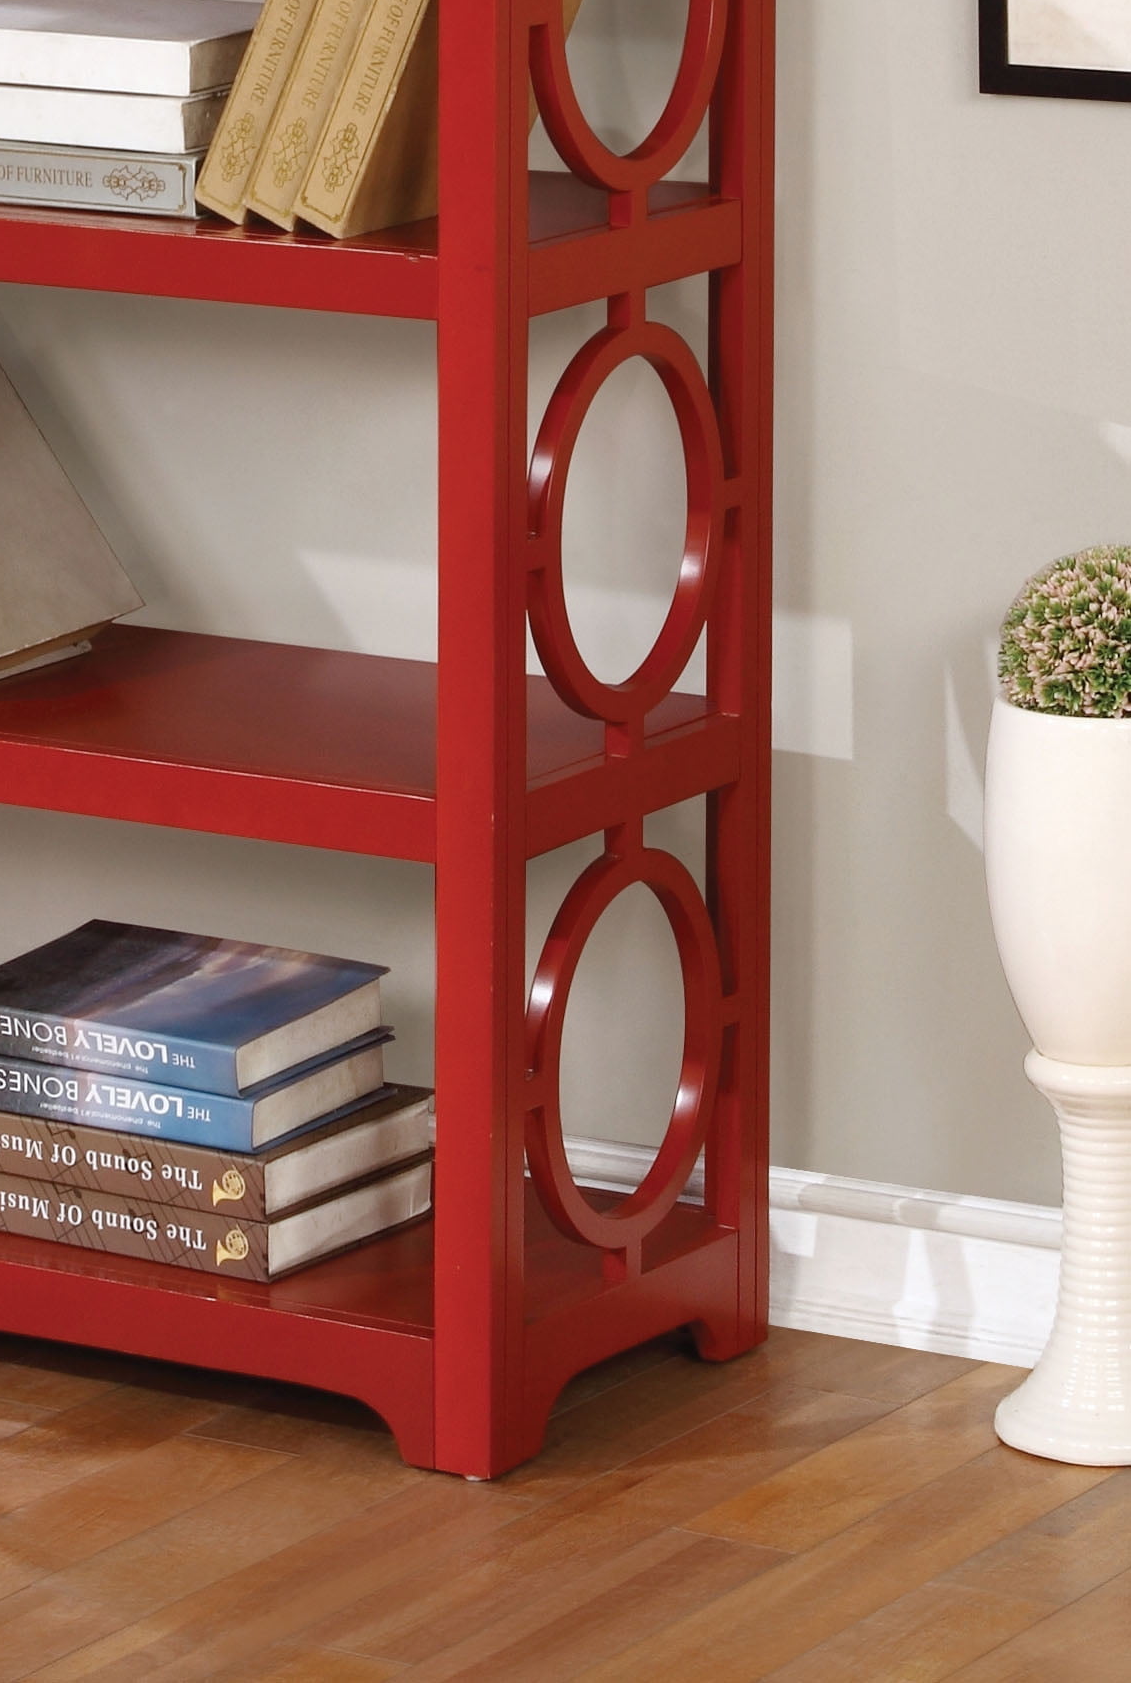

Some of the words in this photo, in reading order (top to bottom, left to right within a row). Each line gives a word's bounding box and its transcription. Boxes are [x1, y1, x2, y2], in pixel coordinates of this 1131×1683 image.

[335, 1, 352, 25] OF
[386, 5, 404, 29] OF
[251, 19, 294, 106] FURNITURE
[301, 21, 346, 110] FURNITURE
[353, 26, 396, 116] FURNITURE
[16, 166, 93, 188] FURNITURE
[74, 1029, 168, 1064] LOVELY
[172, 1053, 196, 1069] THE
[86, 1083, 184, 1117] LOVELY
[187, 1106, 211, 1122] THE
[51, 1144, 76, 1166] Of
[162, 1164, 203, 1190] The
[57, 1203, 82, 1226] Of
[167, 1223, 207, 1250] The
